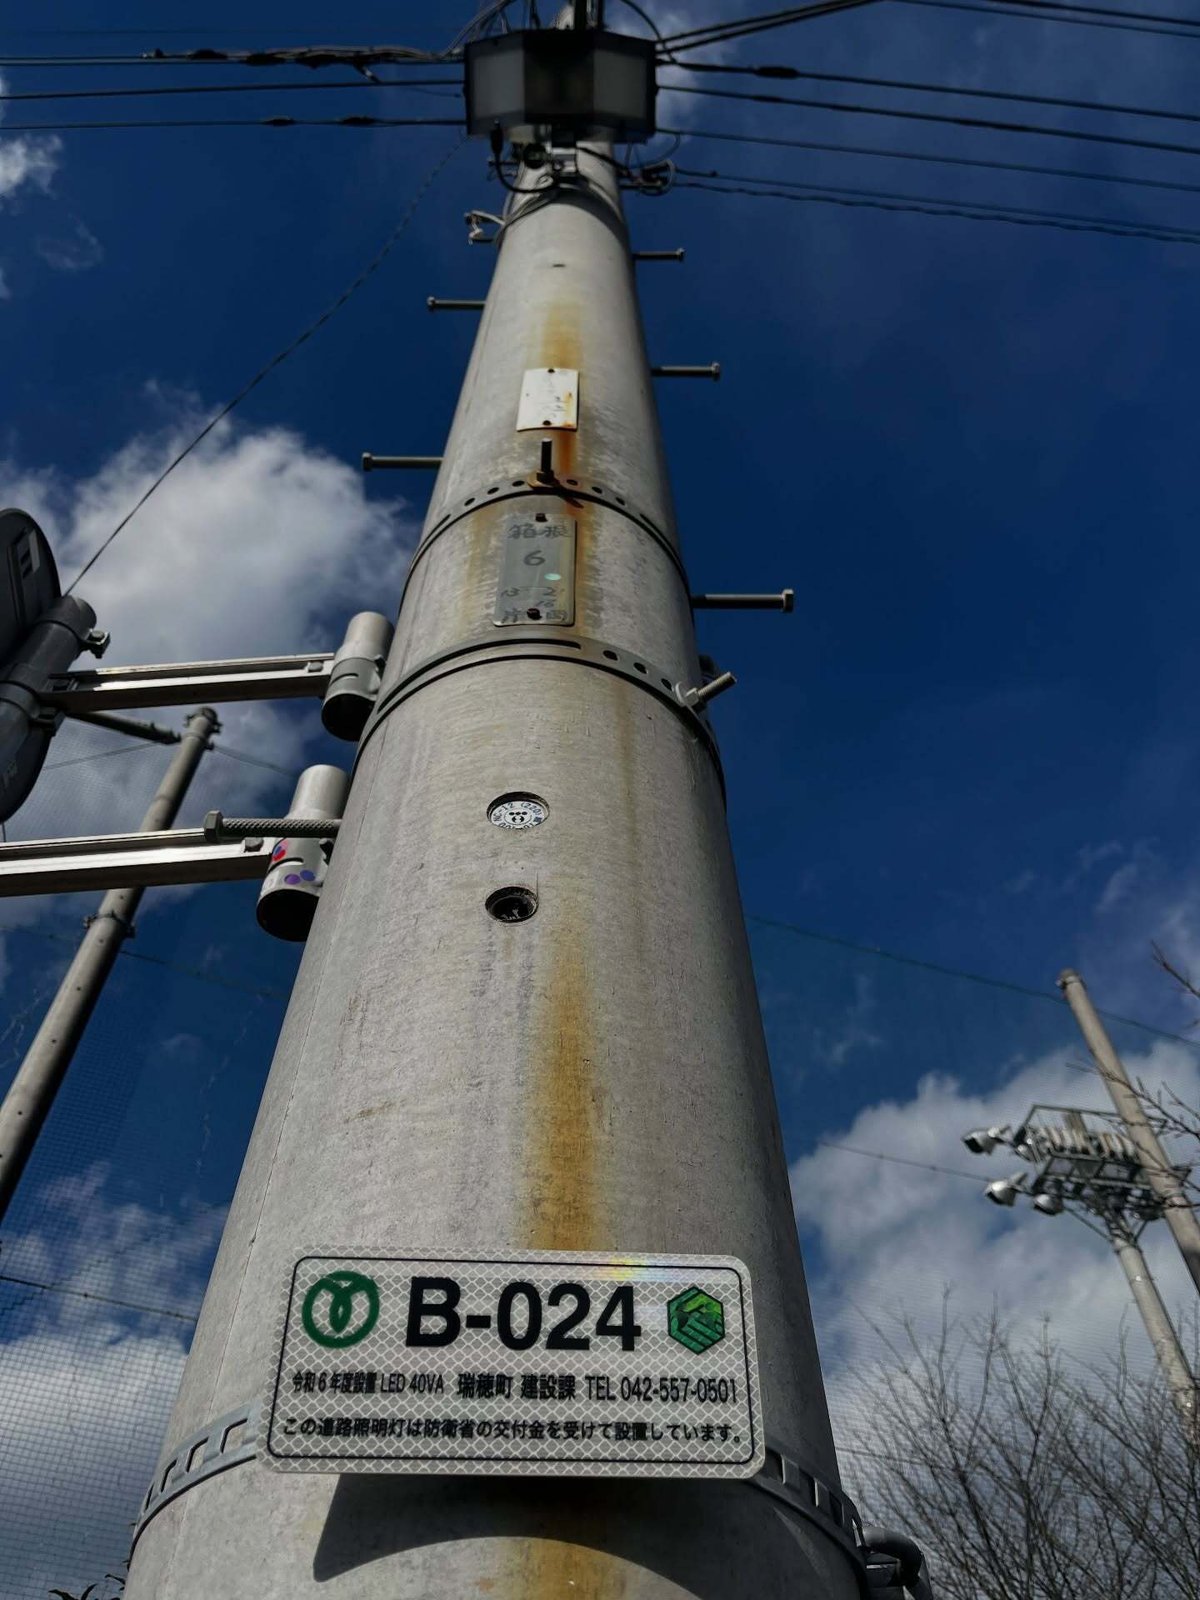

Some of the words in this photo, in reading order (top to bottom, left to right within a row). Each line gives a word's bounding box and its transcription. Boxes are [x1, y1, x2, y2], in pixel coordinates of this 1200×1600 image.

[523, 550, 546, 566] 6
[405, 1276, 641, 1352] B-024
[380, 1373, 406, 1393] LED
[409, 1373, 444, 1394] 40VA
[520, 1374, 576, 1400] 建設課
[585, 1376, 616, 1400] TEL
[621, 1376, 737, 1403] 042-557-0501
